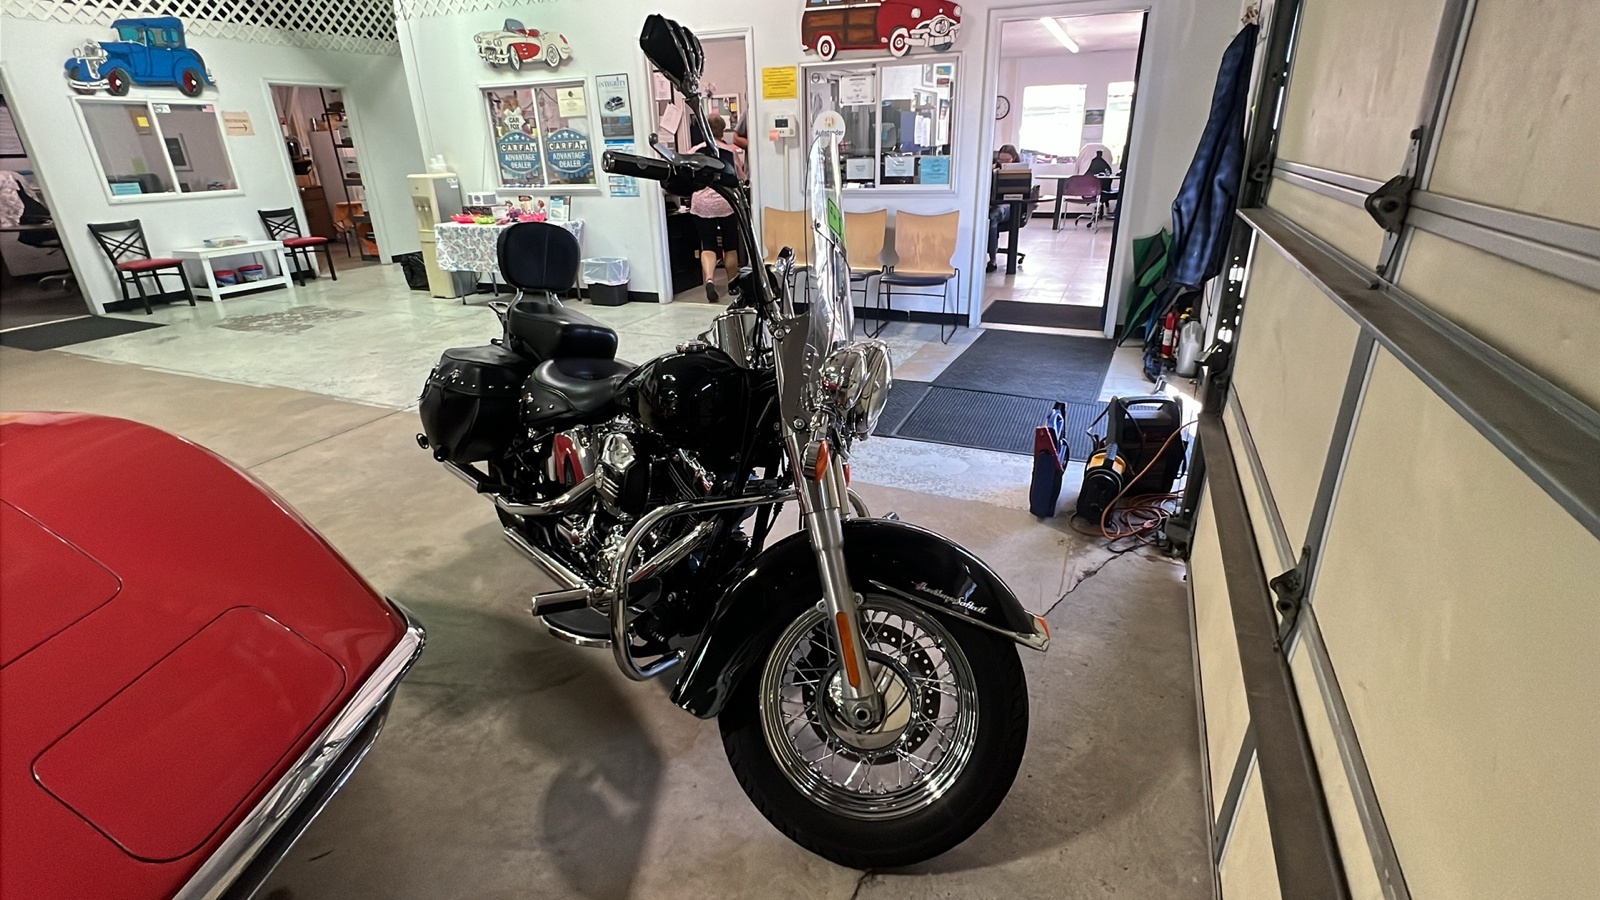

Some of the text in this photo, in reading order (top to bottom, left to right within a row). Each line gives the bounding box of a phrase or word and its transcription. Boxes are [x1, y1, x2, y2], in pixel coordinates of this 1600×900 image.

[501, 143, 537, 152] CARFAX
[548, 141, 587, 150] CARFAX
[504, 153, 536, 161] ADVANTAGE
[552, 151, 586, 160] ADVANTAGE
[510, 161, 532, 169] DEALER
[558, 159, 582, 168] DEALER
